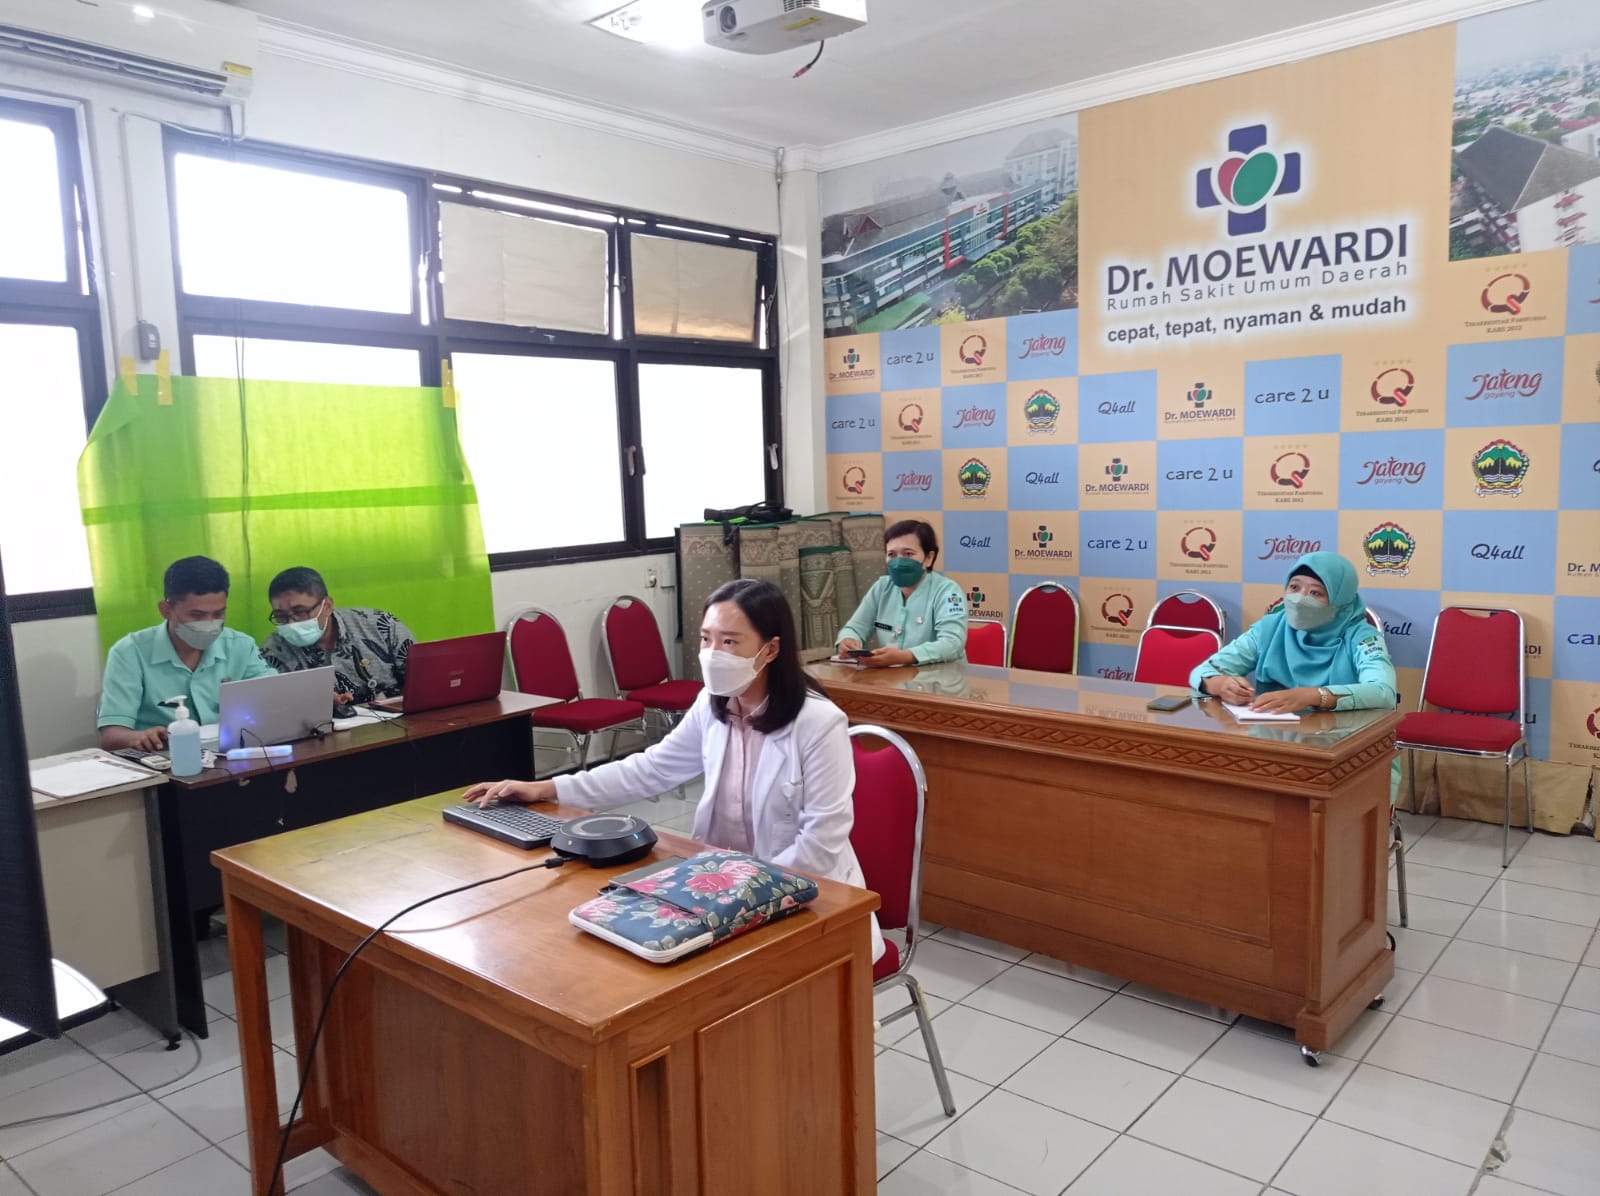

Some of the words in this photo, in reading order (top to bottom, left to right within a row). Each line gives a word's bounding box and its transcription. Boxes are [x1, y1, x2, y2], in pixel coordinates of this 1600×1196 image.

[1107, 264, 1154, 295] Dr.
[1165, 224, 1408, 288] MOEWARDI
[1107, 292, 1171, 311] Rumah
[1180, 283, 1235, 302] Sakit
[1244, 275, 1310, 295] Umum
[1322, 261, 1408, 285] Daerah
[1107, 323, 1160, 344] cepat,
[1165, 316, 1217, 339] tepat,
[1223, 308, 1302, 332] nyaman
[1309, 304, 1324, 321] &
[1331, 296, 1407, 319] mudah
[886, 355, 913, 366] care
[916, 352, 924, 364] 2
[926, 352, 934, 362] u
[1465, 368, 1543, 401] Jateng
[1254, 389, 1296, 404] care
[1301, 388, 1313, 404] 2
[1318, 388, 1330, 401] u
[1098, 400, 1136, 415] Q4all
[1164, 412, 1178, 421] Dr.
[1179, 408, 1236, 419] MOEWARDI
[831, 419, 856, 430] care
[859, 418, 866, 429] 2
[868, 418, 875, 427] u
[1166, 468, 1204, 481] care
[1208, 467, 1218, 481] 2
[1223, 468, 1233, 479] u
[1356, 456, 1426, 485] Jateng
[1025, 472, 1060, 485] Q4all
[1085, 484, 1097, 492] Dr.
[1099, 483, 1150, 491] MOEWARDI
[960, 535, 991, 549] Q4all
[1087, 539, 1121, 550] care
[1125, 538, 1135, 551] 2
[1139, 540, 1148, 550] u
[1015, 549, 1025, 557] Dr.
[1027, 549, 1073, 558] MOEWARDI
[1471, 543, 1525, 560] Q4all
[1567, 562, 1586, 572] Dr.
[968, 609, 1003, 618] OEWARDI
